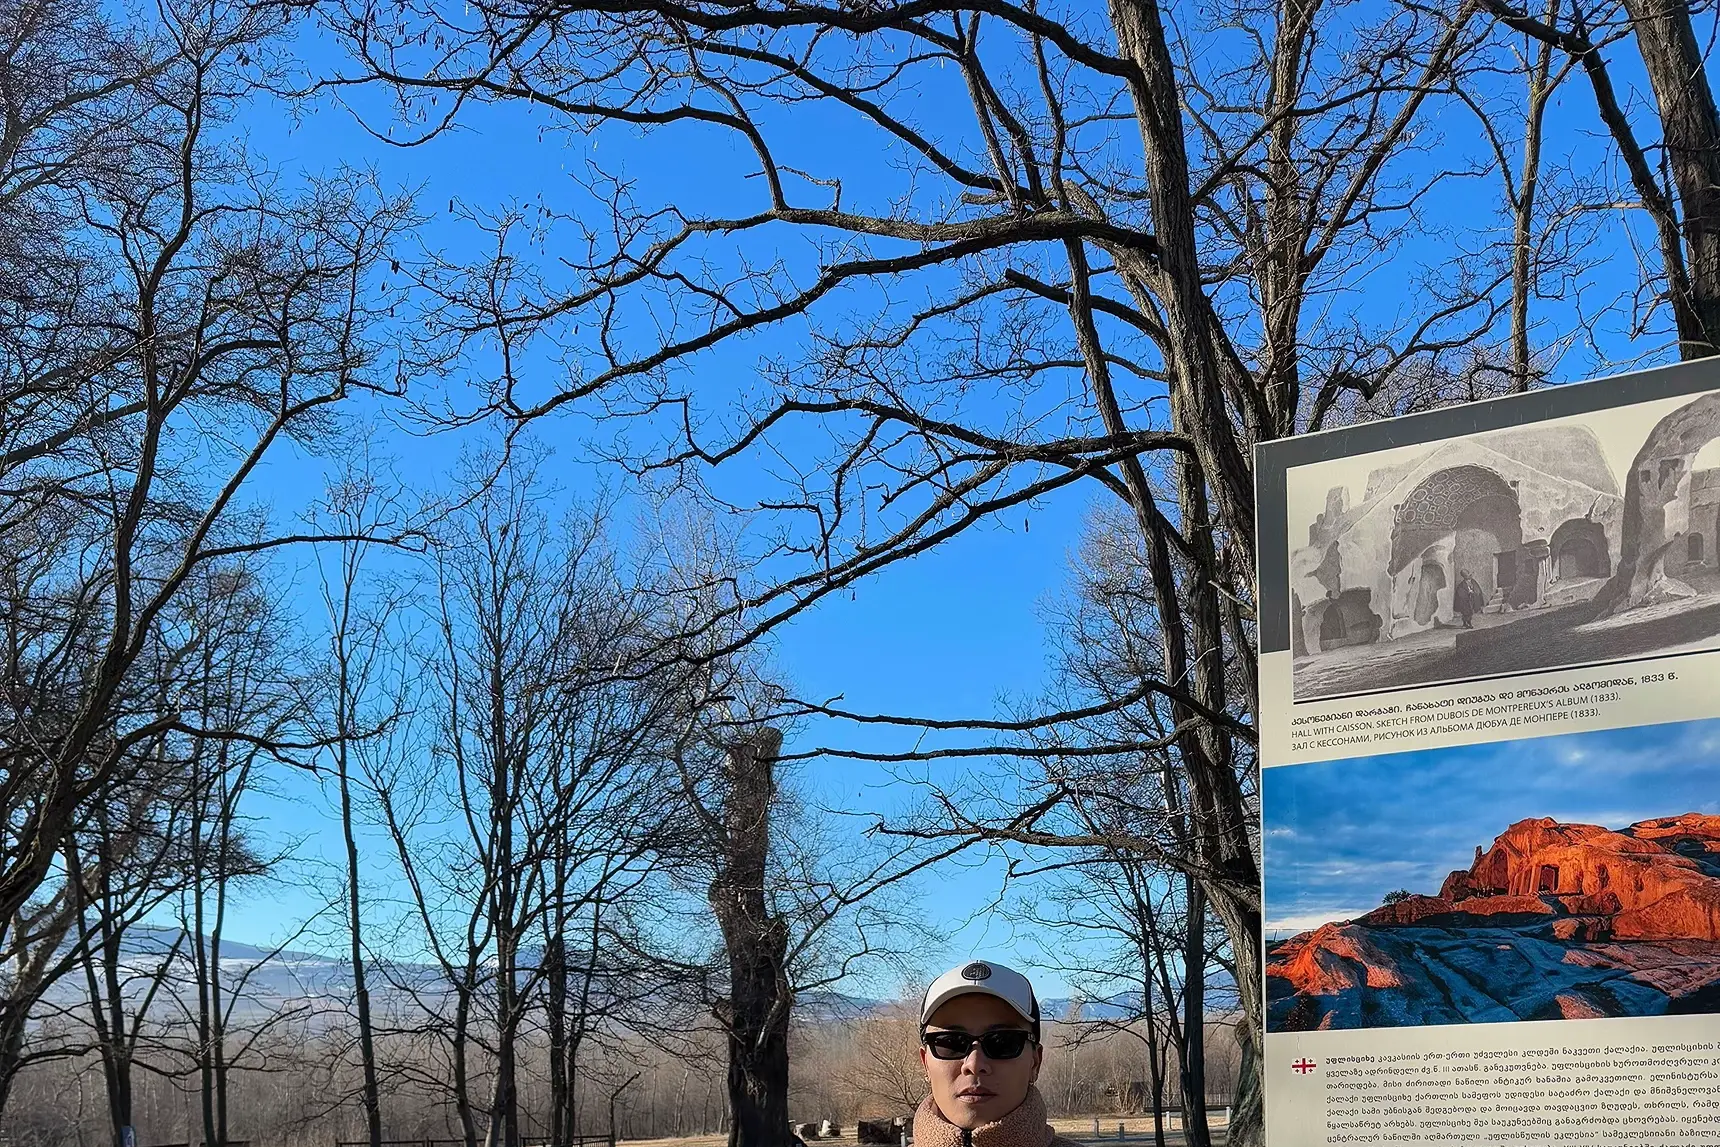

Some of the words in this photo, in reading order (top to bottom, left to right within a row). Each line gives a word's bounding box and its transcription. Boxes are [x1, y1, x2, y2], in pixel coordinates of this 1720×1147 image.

[1291, 729, 1312, 738] HALL
[1312, 726, 1334, 735] WITH
[1335, 721, 1374, 732] CAISSON.
[1375, 717, 1408, 728] SKETCH
[1409, 713, 1435, 724] FROM
[1436, 709, 1470, 720] DUBOIS
[1471, 707, 1483, 716] DE
[1555, 695, 1588, 707] ALBUM
[1590, 691, 1621, 703] (1833).
[1291, 741, 1308, 751] ЗАЛ
[1373, 729, 1415, 740] РИСУНОК
[1416, 727, 1428, 736] ИЗ
[1429, 722, 1474, 734] АЛЬБОМА
[1475, 718, 1508, 730] ДЮБУА
[1508, 716, 1521, 726] ДЕ
[1523, 711, 1568, 723] МОНПЕРЕ
